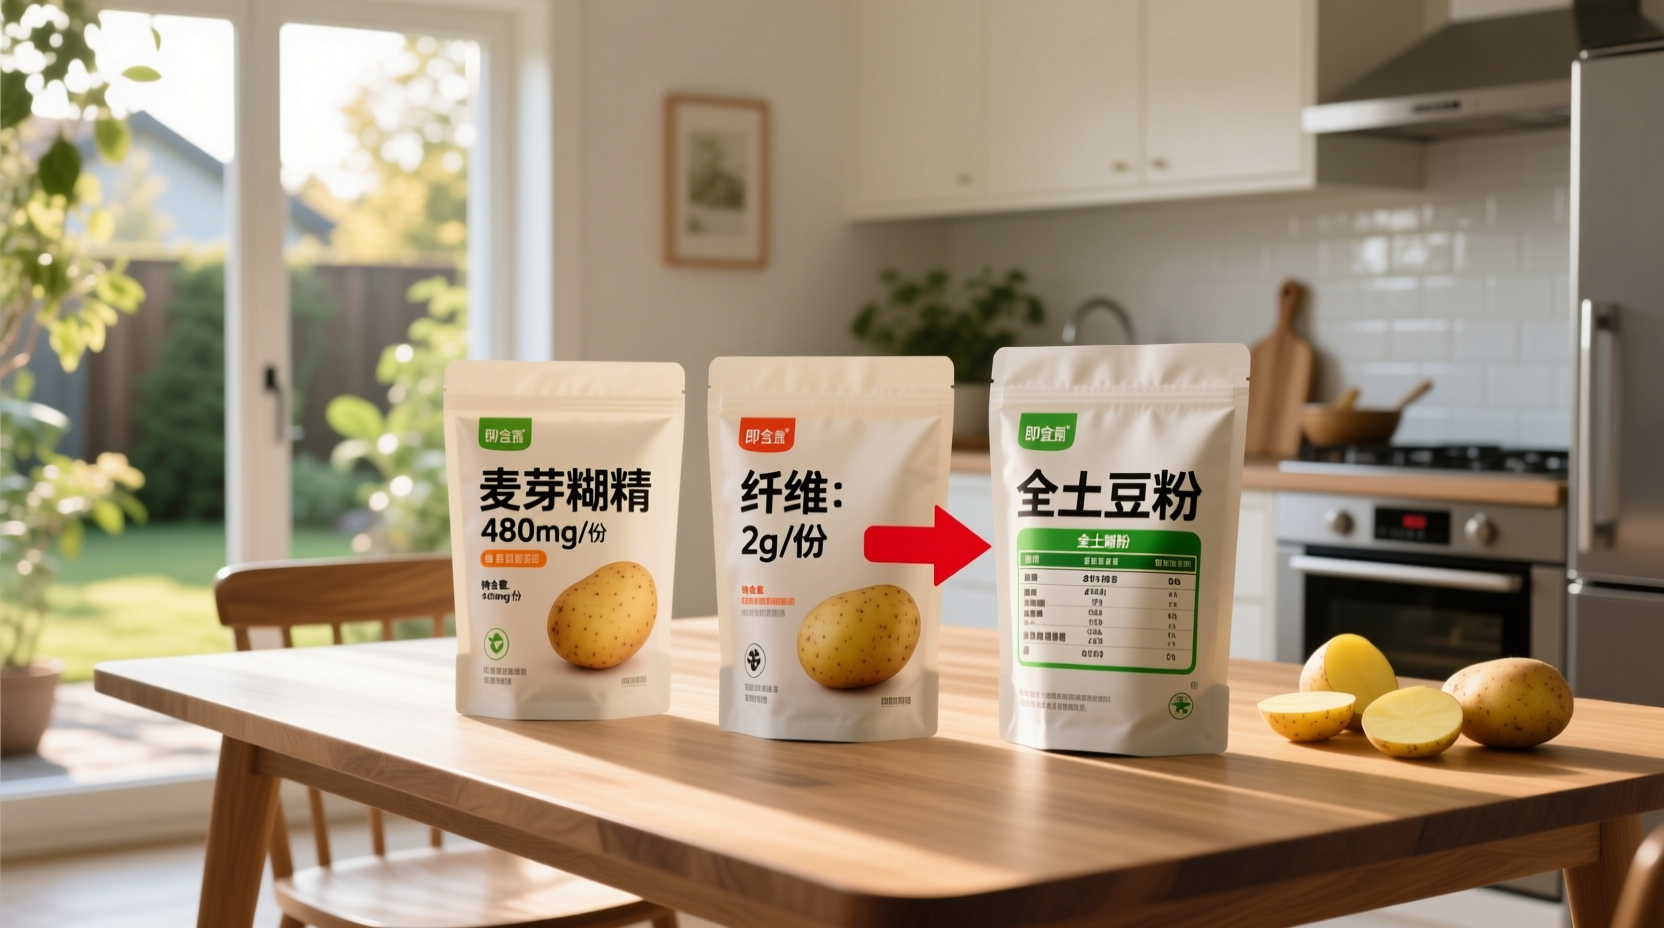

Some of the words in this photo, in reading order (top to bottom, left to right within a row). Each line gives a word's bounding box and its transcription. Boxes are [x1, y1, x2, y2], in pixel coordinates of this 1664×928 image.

[480, 467, 652, 513] 麦芽糊精
[1016, 468, 1203, 522] 全土豆粉
[481, 517, 607, 550] 480mg/份
[741, 523, 828, 562] 2g/份
